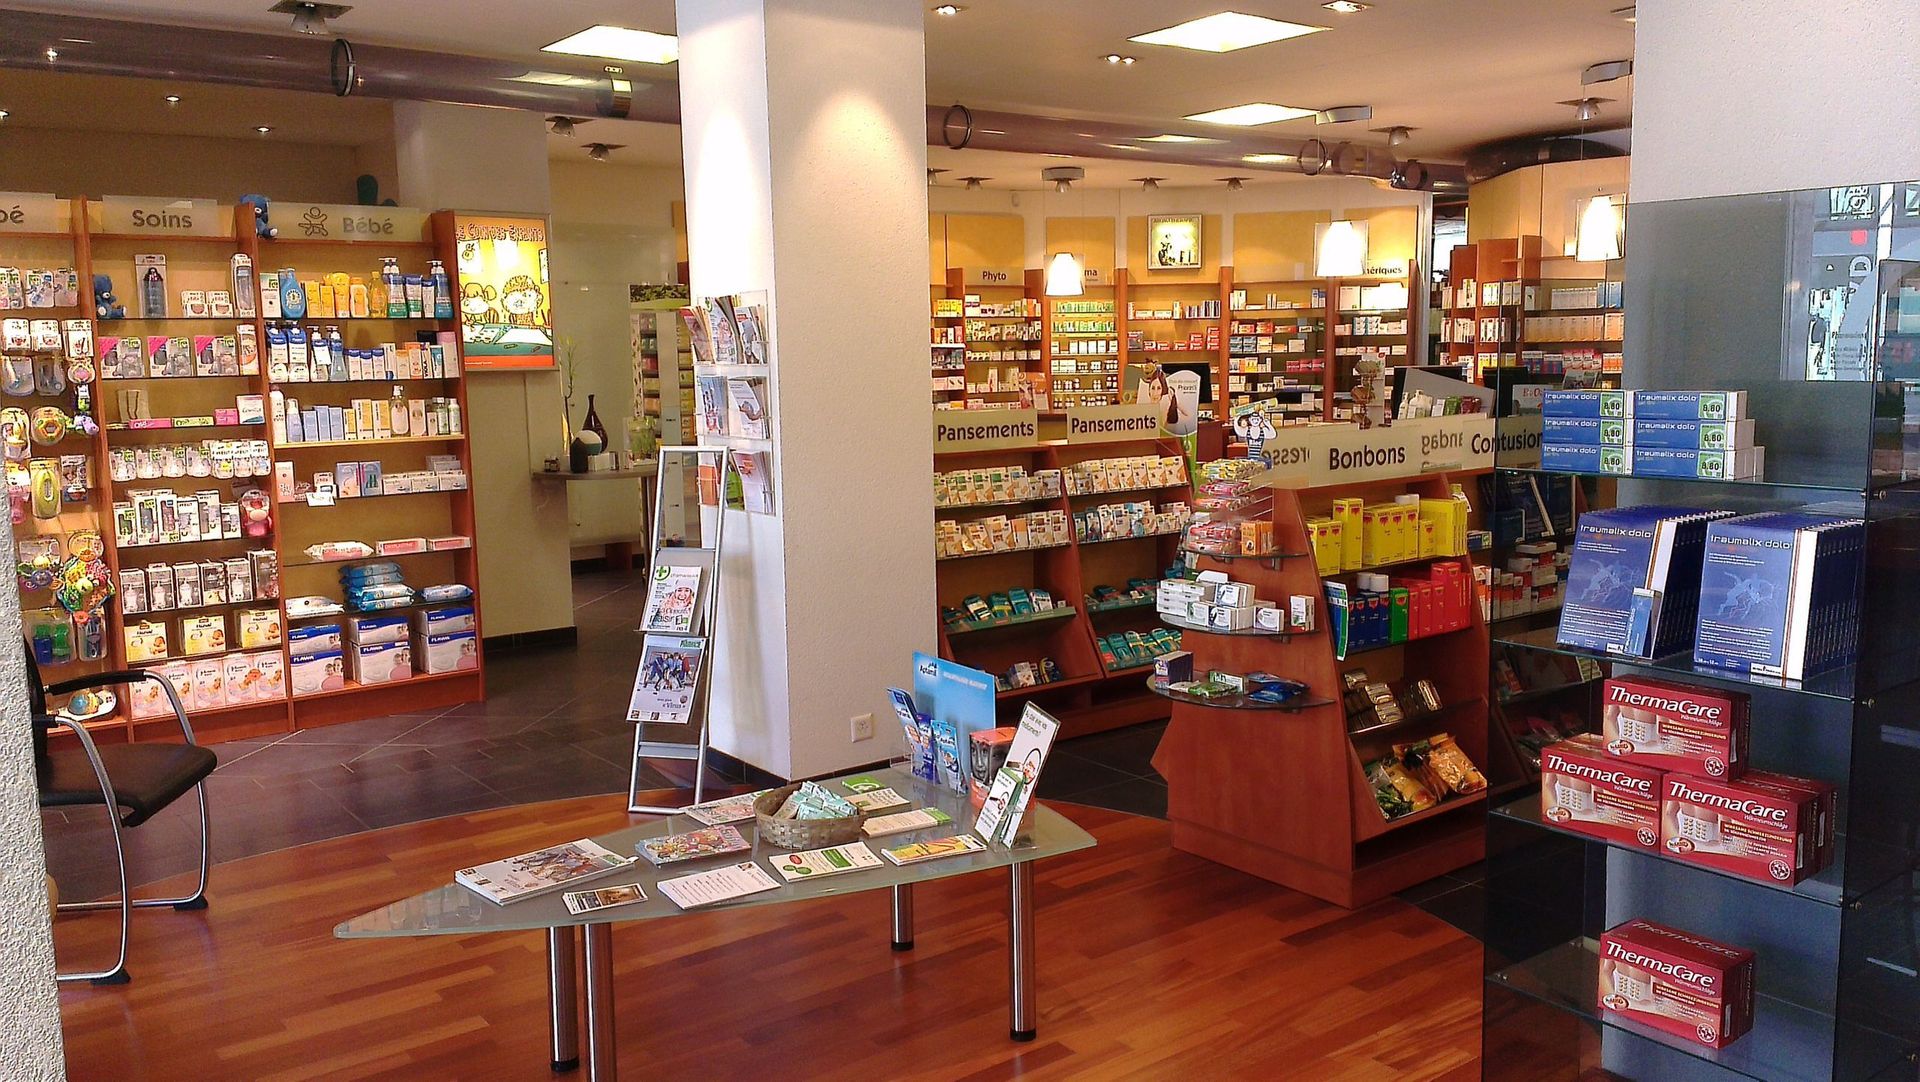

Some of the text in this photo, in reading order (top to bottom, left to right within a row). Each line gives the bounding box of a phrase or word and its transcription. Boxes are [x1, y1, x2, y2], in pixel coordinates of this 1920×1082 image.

[132, 208, 193, 229] Soins
[342, 216, 394, 235] Bébé
[982, 270, 1007, 282] Phyto
[1580, 393, 1598, 401] dolo
[1637, 393, 1698, 402] traumalix dolo
[1603, 401, 1621, 411] 8.80
[1702, 403, 1721, 413] 8.80
[1071, 414, 1156, 433] Pansements
[1580, 420, 1598, 428] dolo
[1637, 421, 1696, 431] traumalix dolo
[937, 420, 1034, 441] Pansements
[1603, 428, 1621, 438] 8.80
[1703, 433, 1722, 443] 8.80
[1579, 446, 1597, 455] dolo
[1636, 449, 1696, 459] traumalix dolo
[1329, 444, 1406, 470] Bonbons
[1603, 457, 1621, 466] 8.80
[1701, 461, 1719, 471] 8.80
[1580, 524, 1652, 539] traumalix dolo
[1710, 533, 1792, 550] traumalix dolo
[363, 644, 384, 653] FLAWA
[293, 654, 315, 663] FLAWA
[1610, 685, 1722, 720] ThermaCare
[1547, 754, 1652, 792] ThermaCare
[1669, 781, 1787, 822] ThermaCare
[1606, 940, 1715, 988] ThermaCare
